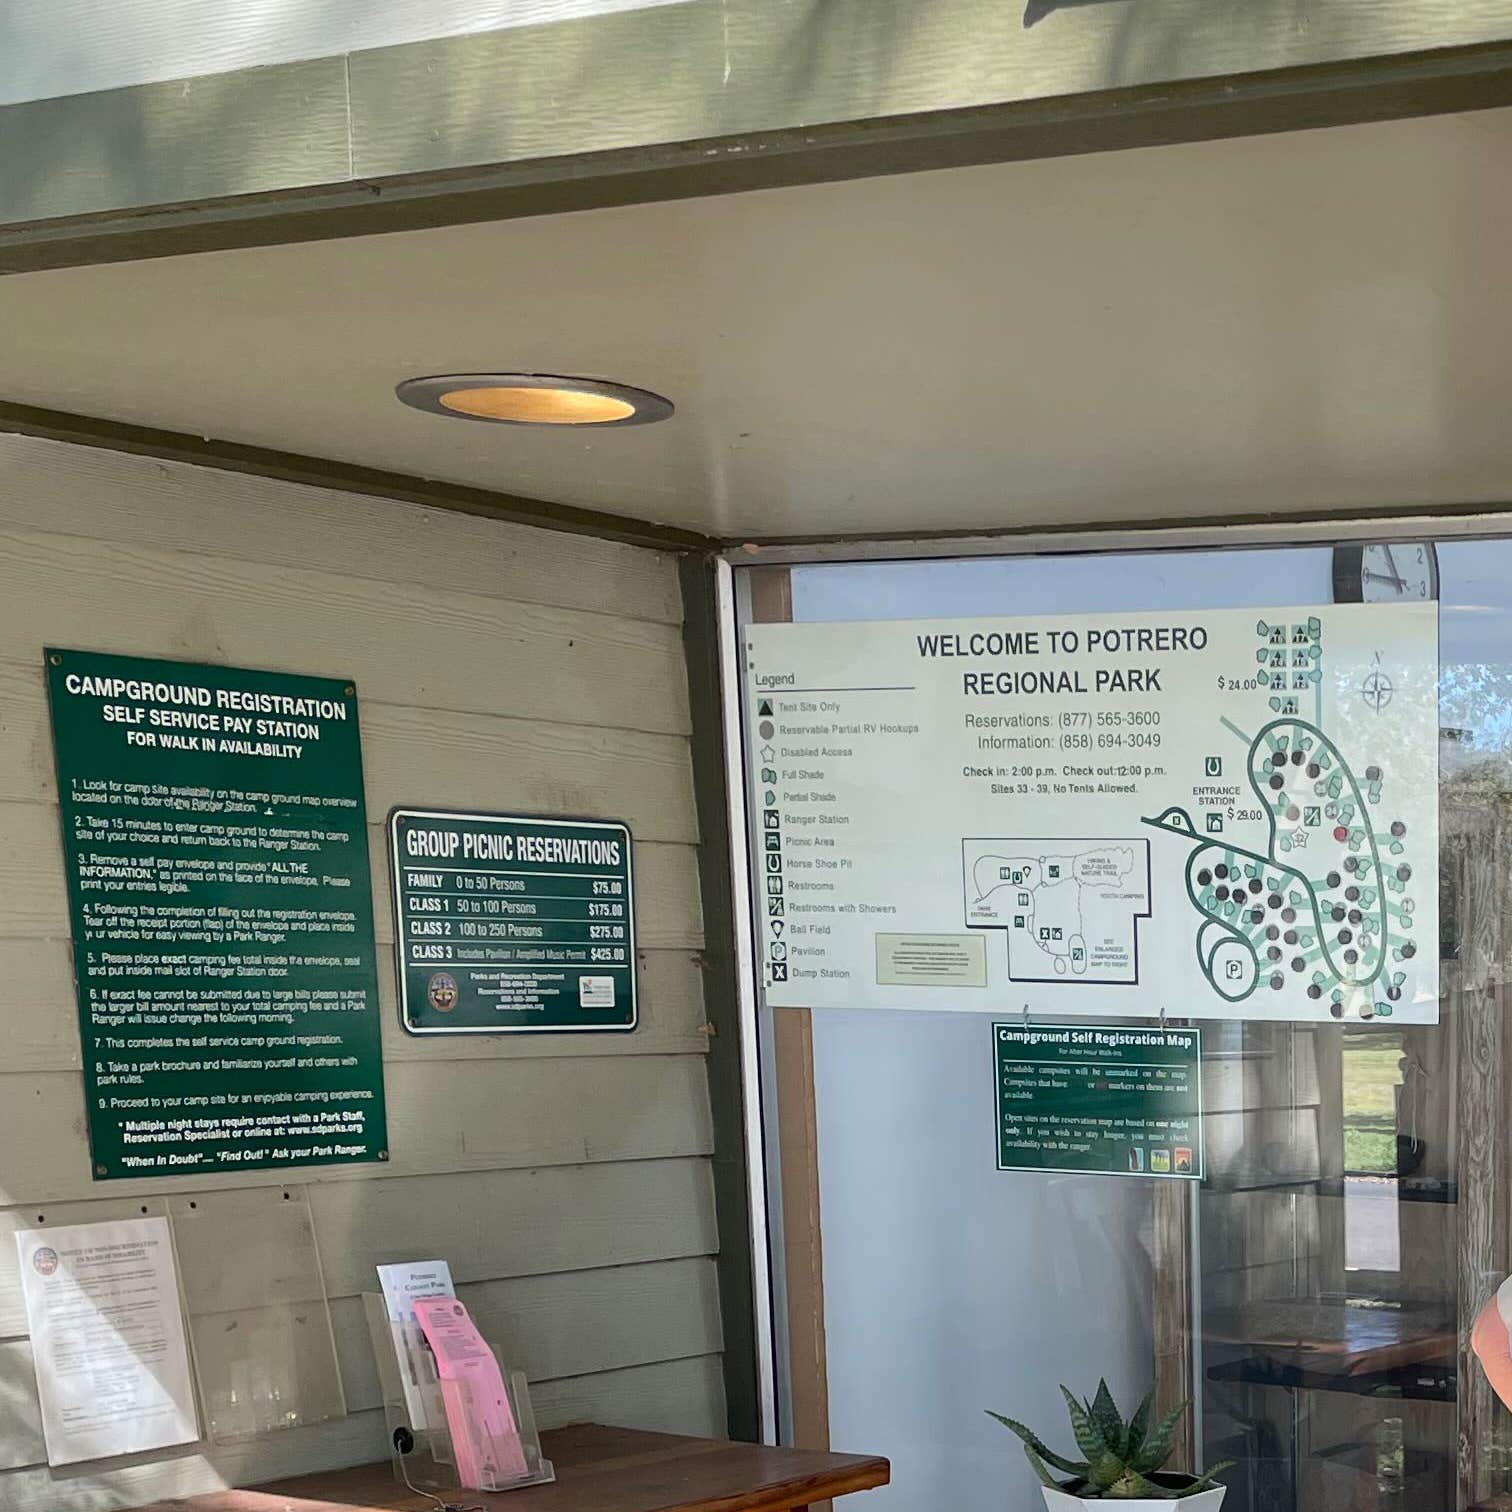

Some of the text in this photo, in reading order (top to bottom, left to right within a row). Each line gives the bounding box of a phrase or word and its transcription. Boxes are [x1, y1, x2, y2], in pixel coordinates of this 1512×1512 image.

[1417, 547, 1423, 564] 2
[1420, 581, 1426, 597] 3
[918, 627, 1208, 657] WELCOME TO POTRERO
[755, 673, 795, 688] Legend
[963, 669, 1162, 695] REGIONAL PARK
[1229, 679, 1256, 690] 24.00
[66, 674, 346, 720] CAMPGROUND REGISTRATION
[779, 702, 840, 713] Tent Site Only
[103, 705, 320, 740] SELF SERVICE PAY STATION
[965, 711, 1161, 728] Reservations: (877) 565-3600
[780, 725, 829, 734] Reservable
[832, 724, 861, 733] Partial
[864, 724, 877, 733] RV
[127, 732, 302, 759] FOR WALK IN AVAILABILITY
[978, 734, 1161, 750] Information: (858) 694-3049
[781, 748, 852, 757] Disabled Access
[782, 770, 824, 779] Full Shade
[963, 766, 993, 777] Check
[996, 766, 1009, 777] in:
[1012, 766, 1033, 777] 2:00
[1036, 768, 1057, 780] p.m.
[1063, 765, 1094, 777] Check
[1145, 767, 1167, 779] p.m.
[784, 792, 836, 801] Partial Shade
[991, 784, 1014, 794] Sites
[1018, 784, 1028, 794] 33
[1053, 784, 1067, 794] No
[1069, 784, 1094, 794] Tents
[1097, 784, 1138, 794] Allowed.
[1193, 787, 1241, 796] ENTRANCE
[1199, 797, 1235, 805] STATION
[785, 815, 849, 826] Ranger Station
[1237, 810, 1262, 820] 29.00
[407, 830, 620, 865] GROUP PICNIC RESERVATIONS
[786, 837, 835, 846] Picnic Area
[787, 860, 812, 868] Horse
[815, 859, 837, 868] Shoe
[408, 874, 622, 895] FAMILY 0 to 50 Persons $75.00
[788, 881, 834, 890] Restrooms
[410, 898, 622, 917] CLASS 1 50 to 100 Persons $175.00
[789, 903, 896, 913] Restrooms with Showers
[411, 922, 624, 939] CLASS 2 100 to 250 Persons $275.00
[810, 925, 831, 935] Field
[412, 945, 444, 959] CLASS
[446, 946, 452, 958] 3
[591, 948, 625, 961] $425.00
[792, 947, 826, 955] Pavilion
[161, 954, 186, 964] exact
[793, 969, 850, 978] Dump Station
[1000, 1030, 1192, 1048] Campground Self Registration Map
[126, 1120, 165, 1133] Multiple
[168, 1119, 192, 1131] night
[194, 1118, 220, 1130] stays
[222, 1116, 254, 1129] require
[256, 1115, 290, 1126] contact
[292, 1114, 311, 1124] with
[320, 1112, 340, 1122] Park
[124, 1131, 182, 1144] Reservation
[184, 1129, 231, 1142] Specialist
[232, 1130, 243, 1138] or
[244, 1127, 272, 1138] online
[288, 1122, 363, 1137] www.sdparks.org
[156, 1154, 167, 1166] In
[272, 1149, 288, 1159] Ask
[290, 1148, 311, 1159] your
[313, 1145, 332, 1156] Park
